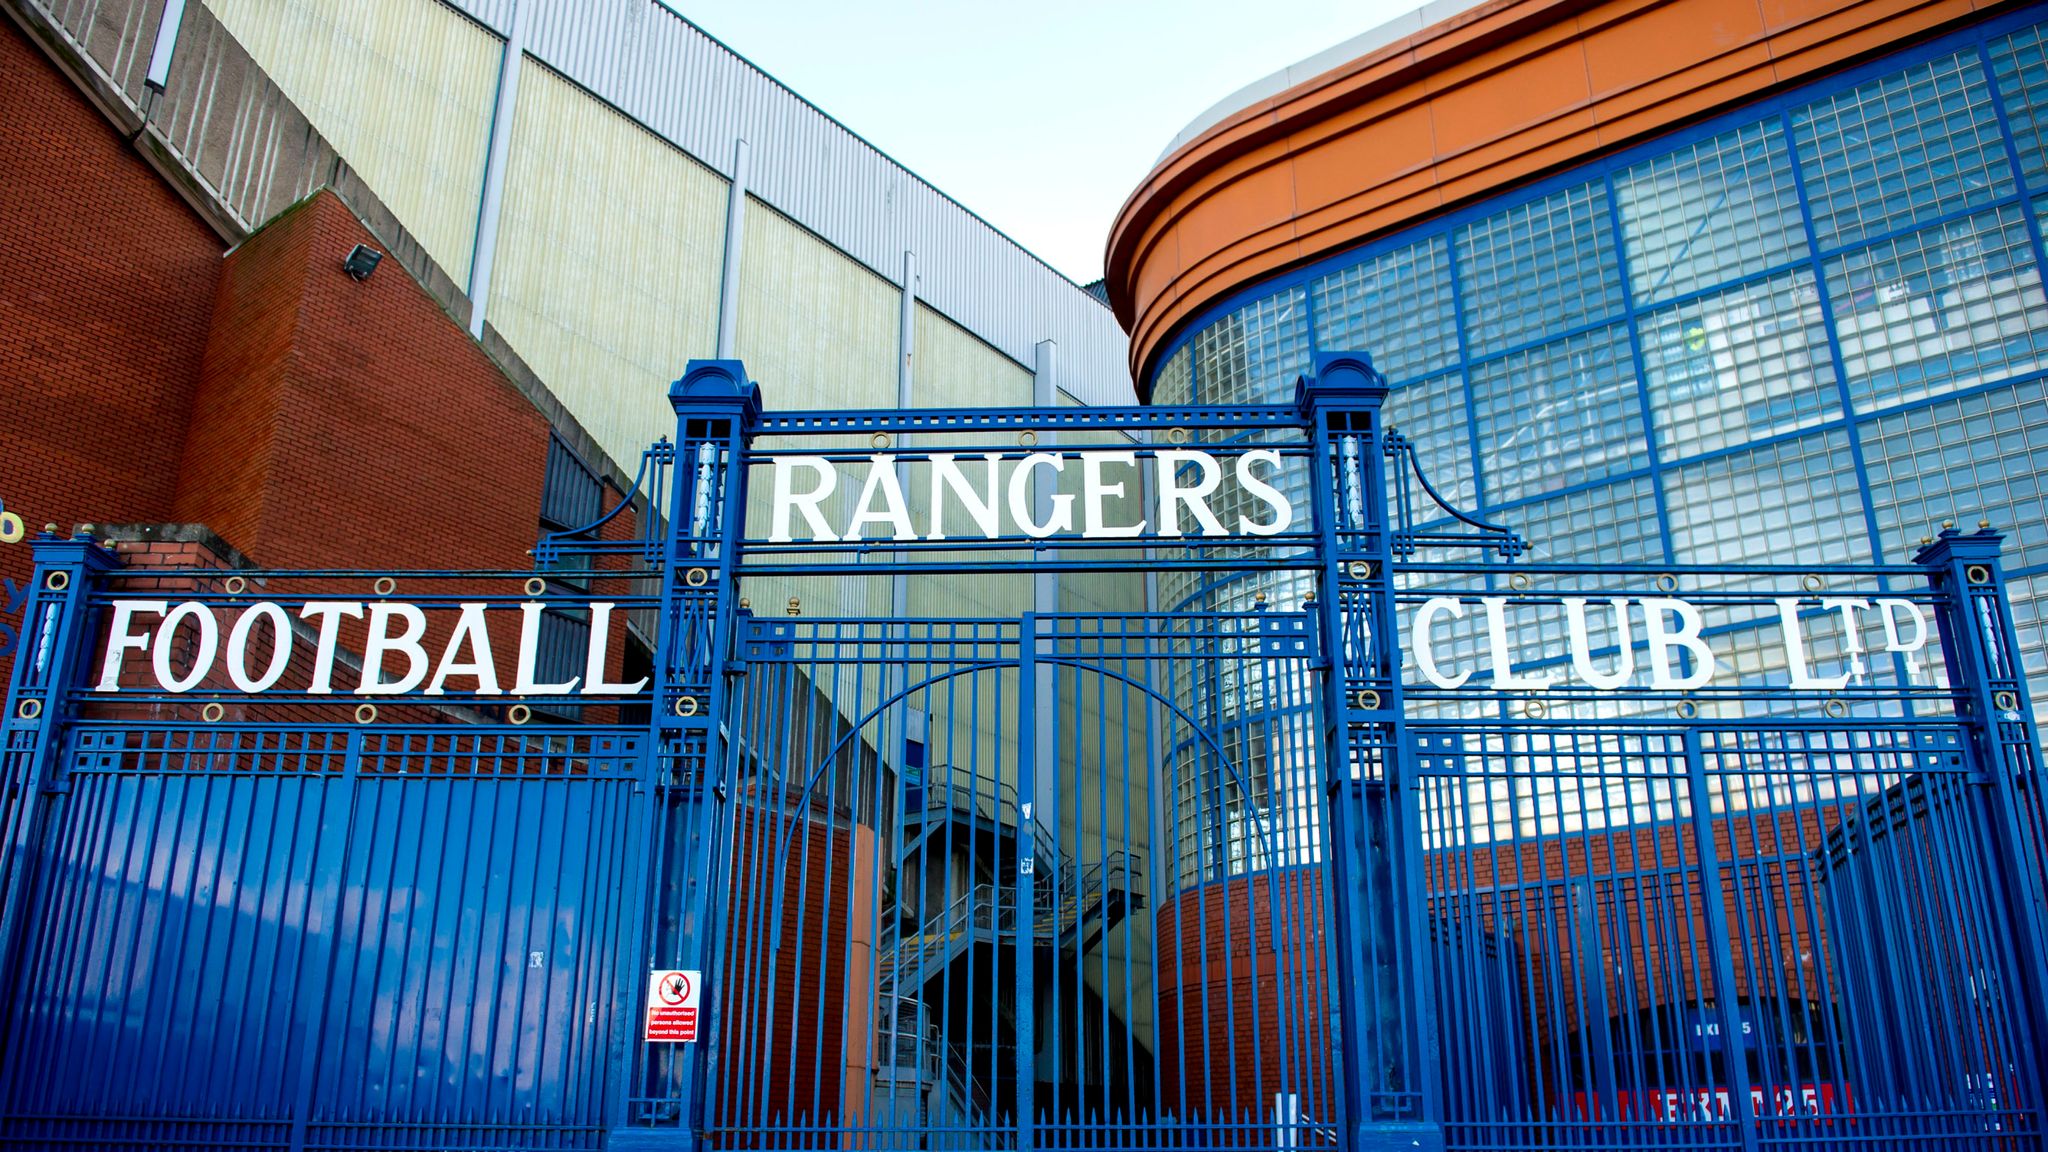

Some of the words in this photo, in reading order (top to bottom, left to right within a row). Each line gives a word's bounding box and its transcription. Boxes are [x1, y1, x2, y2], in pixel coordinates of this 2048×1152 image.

[768, 449, 1293, 542] RANGERS
[95, 600, 650, 695] FOOTBALL
[1412, 597, 1715, 690] CLUB
